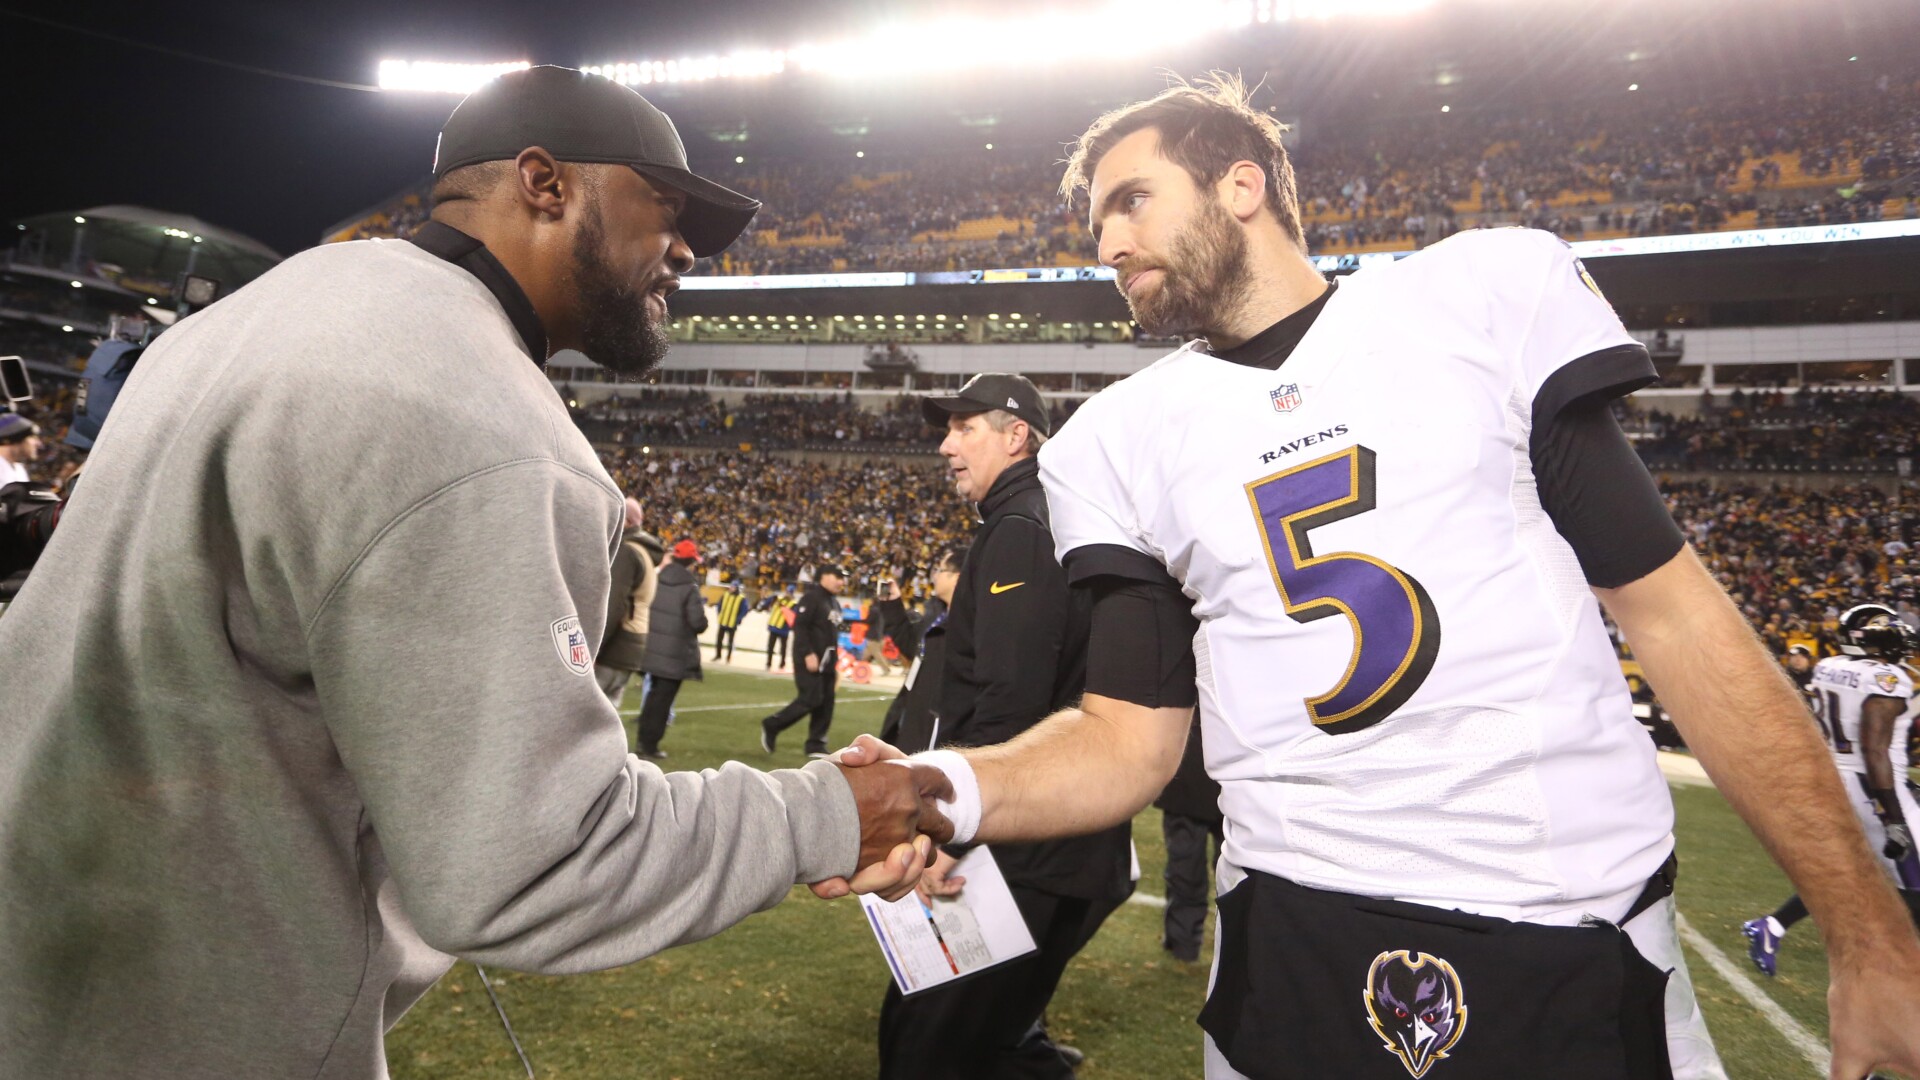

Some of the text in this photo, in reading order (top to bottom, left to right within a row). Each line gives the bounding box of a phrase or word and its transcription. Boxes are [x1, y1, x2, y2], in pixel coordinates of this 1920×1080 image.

[1731, 234, 1765, 244] WIN
[1824, 227, 1861, 239] WIN
[1275, 394, 1299, 410] NFL
[1259, 424, 1349, 464] RAVENS
[1243, 443, 1441, 736] 5
[572, 646, 589, 664] NFL
